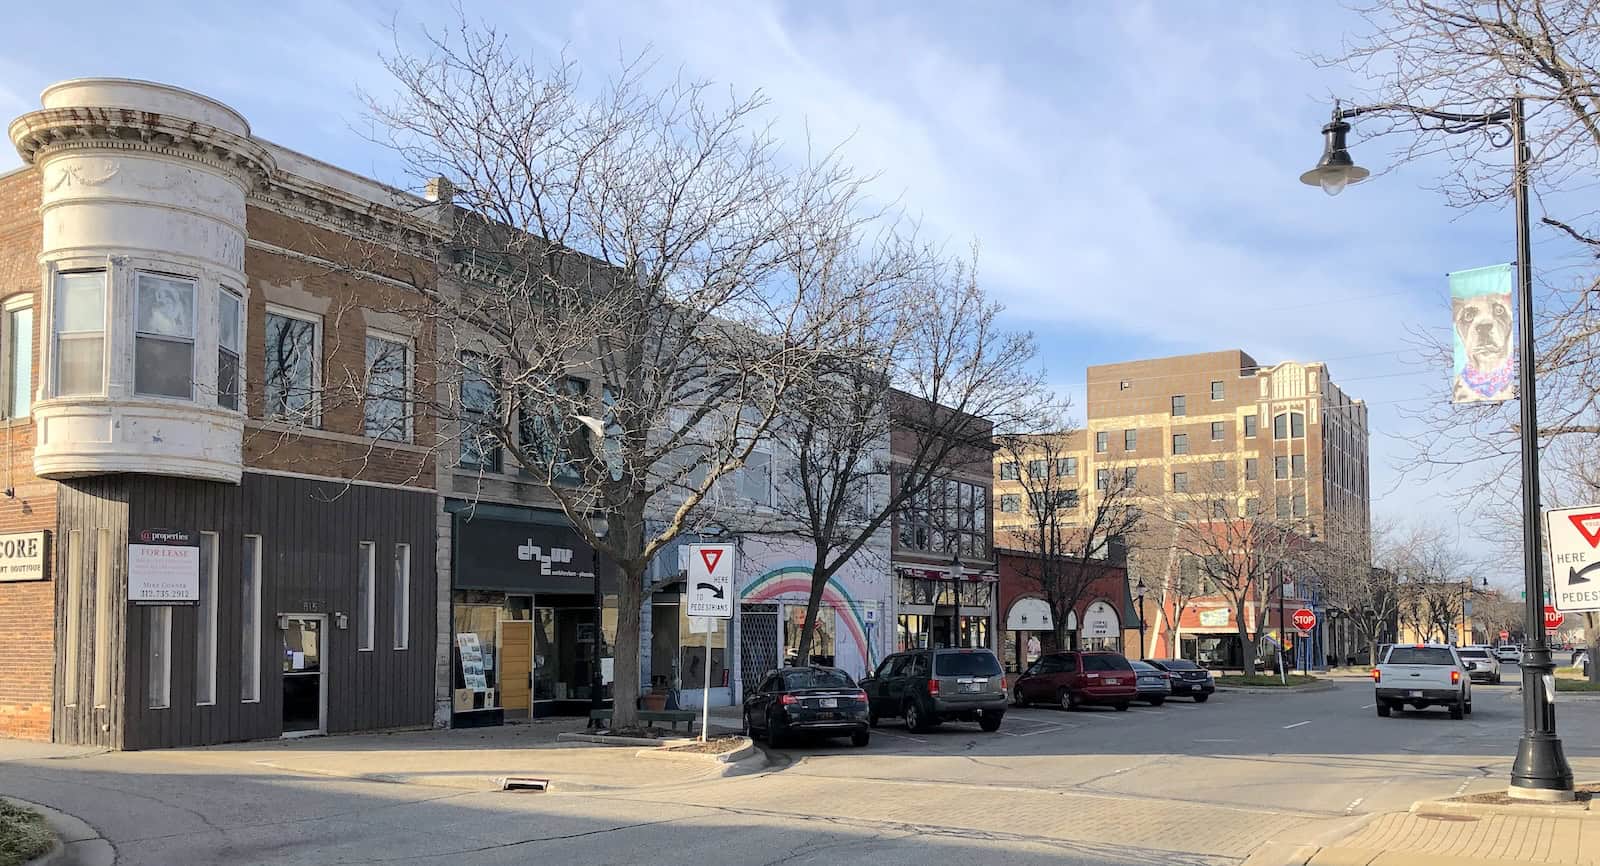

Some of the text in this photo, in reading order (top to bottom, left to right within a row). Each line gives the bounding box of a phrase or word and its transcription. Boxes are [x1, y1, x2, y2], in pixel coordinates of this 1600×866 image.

[142, 548, 190, 557] FOR LEASE
[1557, 552, 1586, 564] HERE
[10, 564, 40, 573] BOUTIQUE
[713, 576, 728, 584] HERE
[696, 593, 703, 601] TO
[690, 603, 728, 612] PEDESTRIANS
[1294, 615, 1314, 625] STOP
[1544, 612, 1562, 622] TOP
